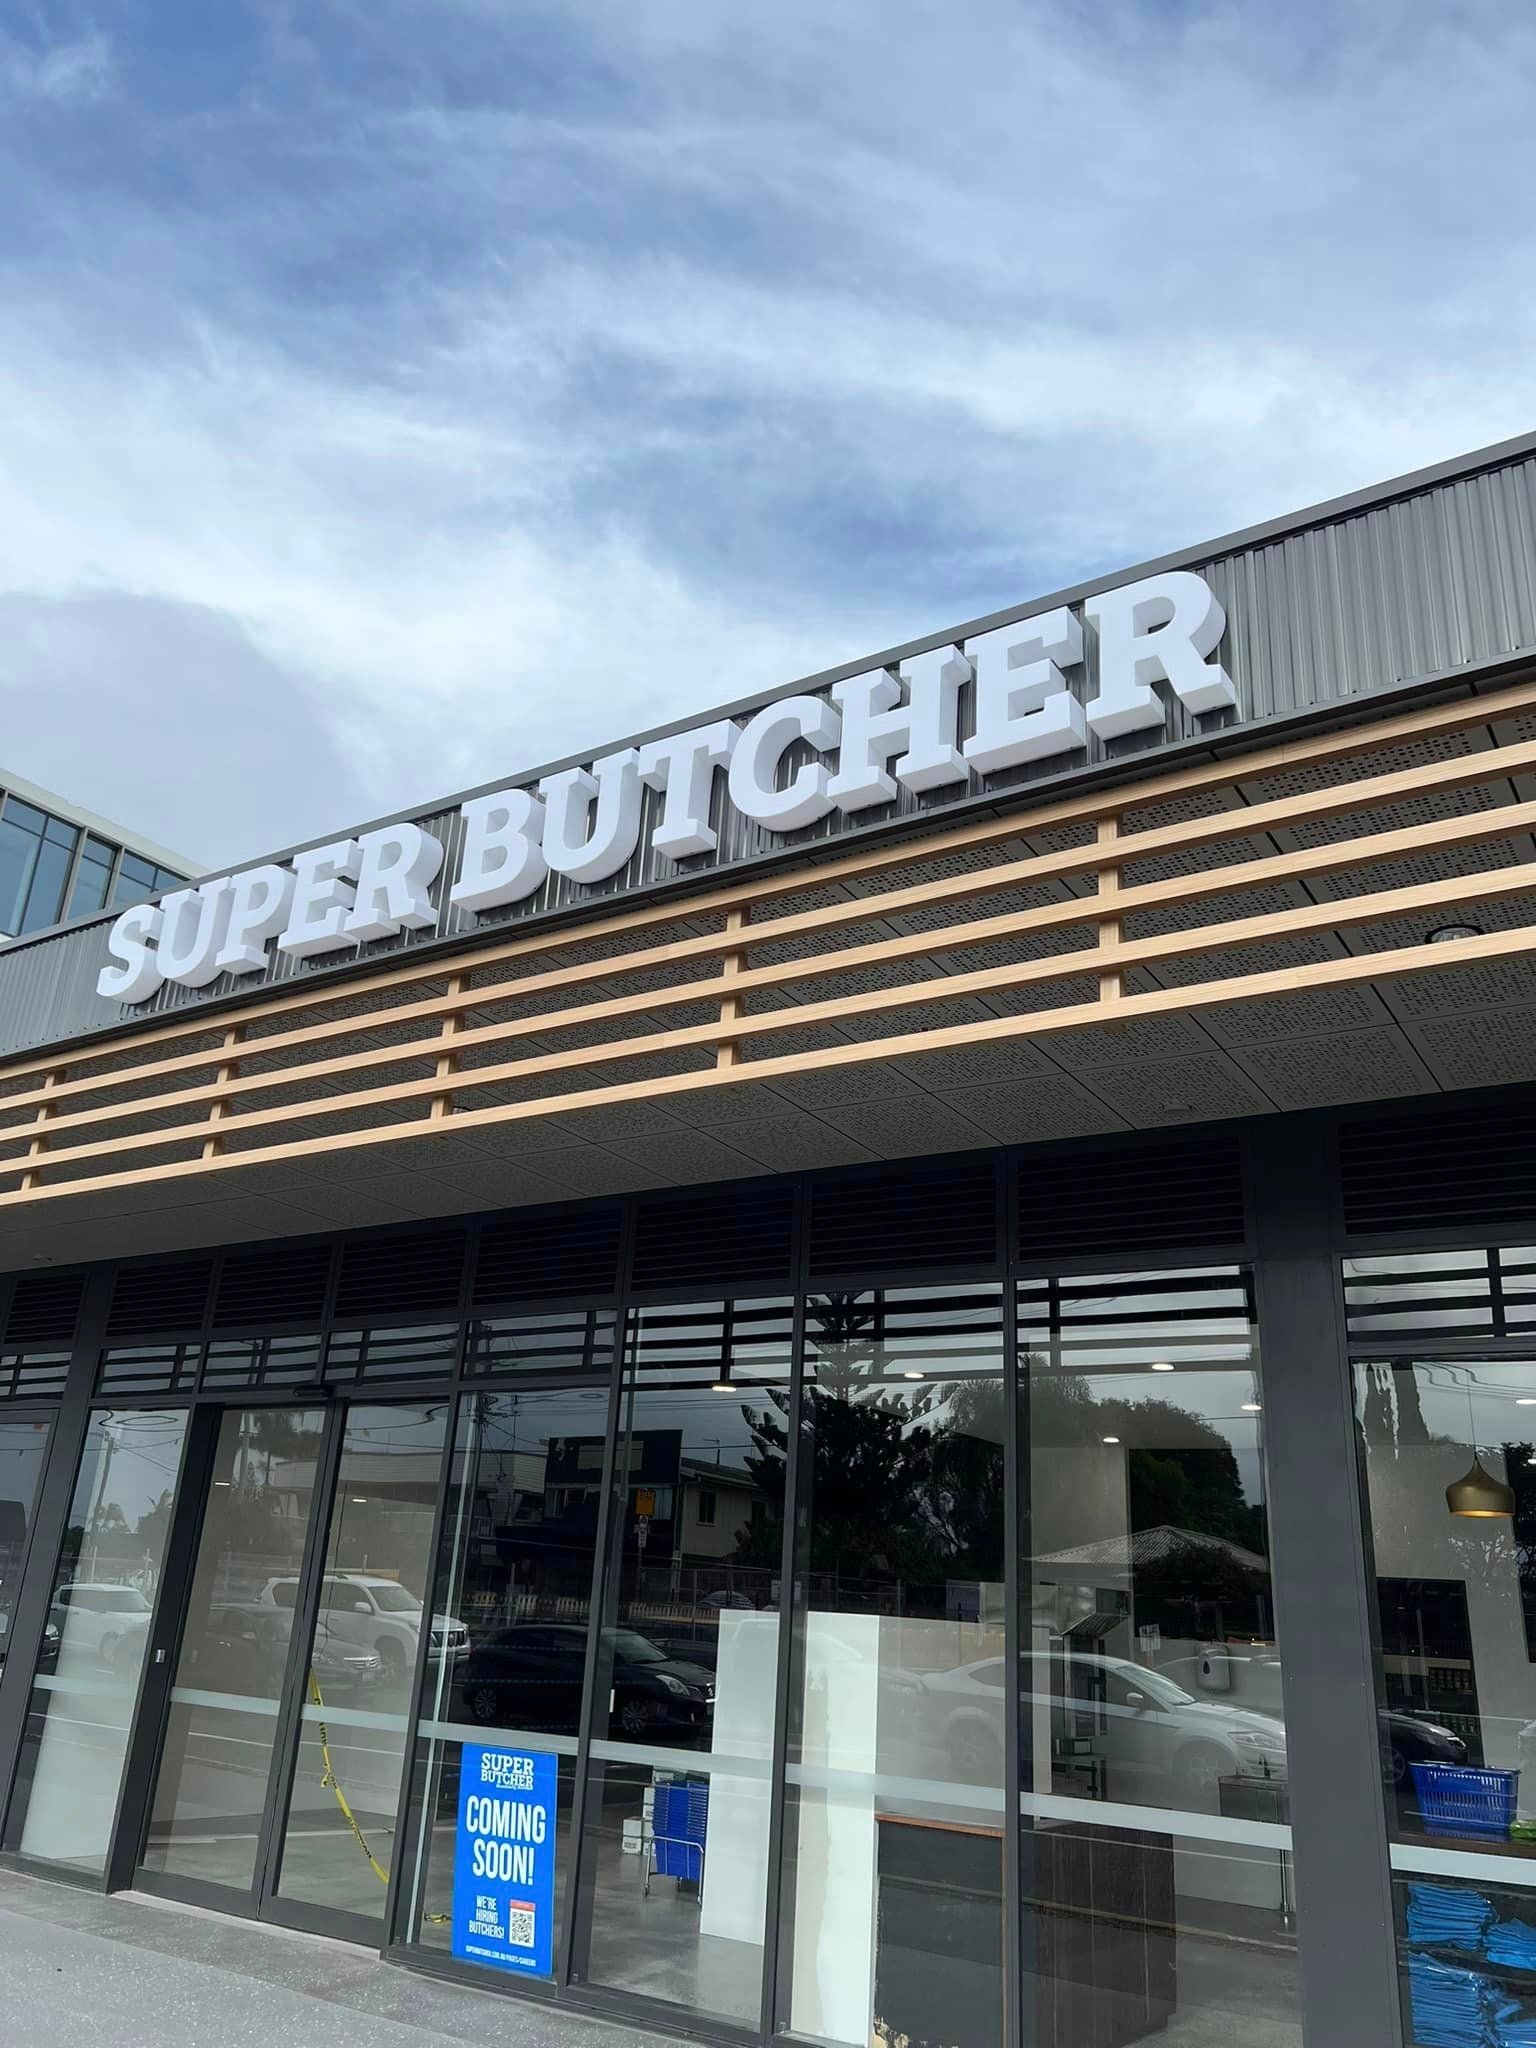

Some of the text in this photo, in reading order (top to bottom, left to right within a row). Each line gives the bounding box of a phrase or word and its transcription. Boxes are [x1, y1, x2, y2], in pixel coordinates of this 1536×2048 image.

[96, 570, 1238, 1004] SUPER BUTCHER
[481, 1752, 534, 1776] SUPER
[480, 1769, 534, 1788] BUTCHER
[466, 1795, 546, 1844] COMING
[472, 1838, 535, 1886] SOON!
[476, 1908, 499, 1924] HIRING
[468, 1920, 505, 1939] BUTCHERS!
